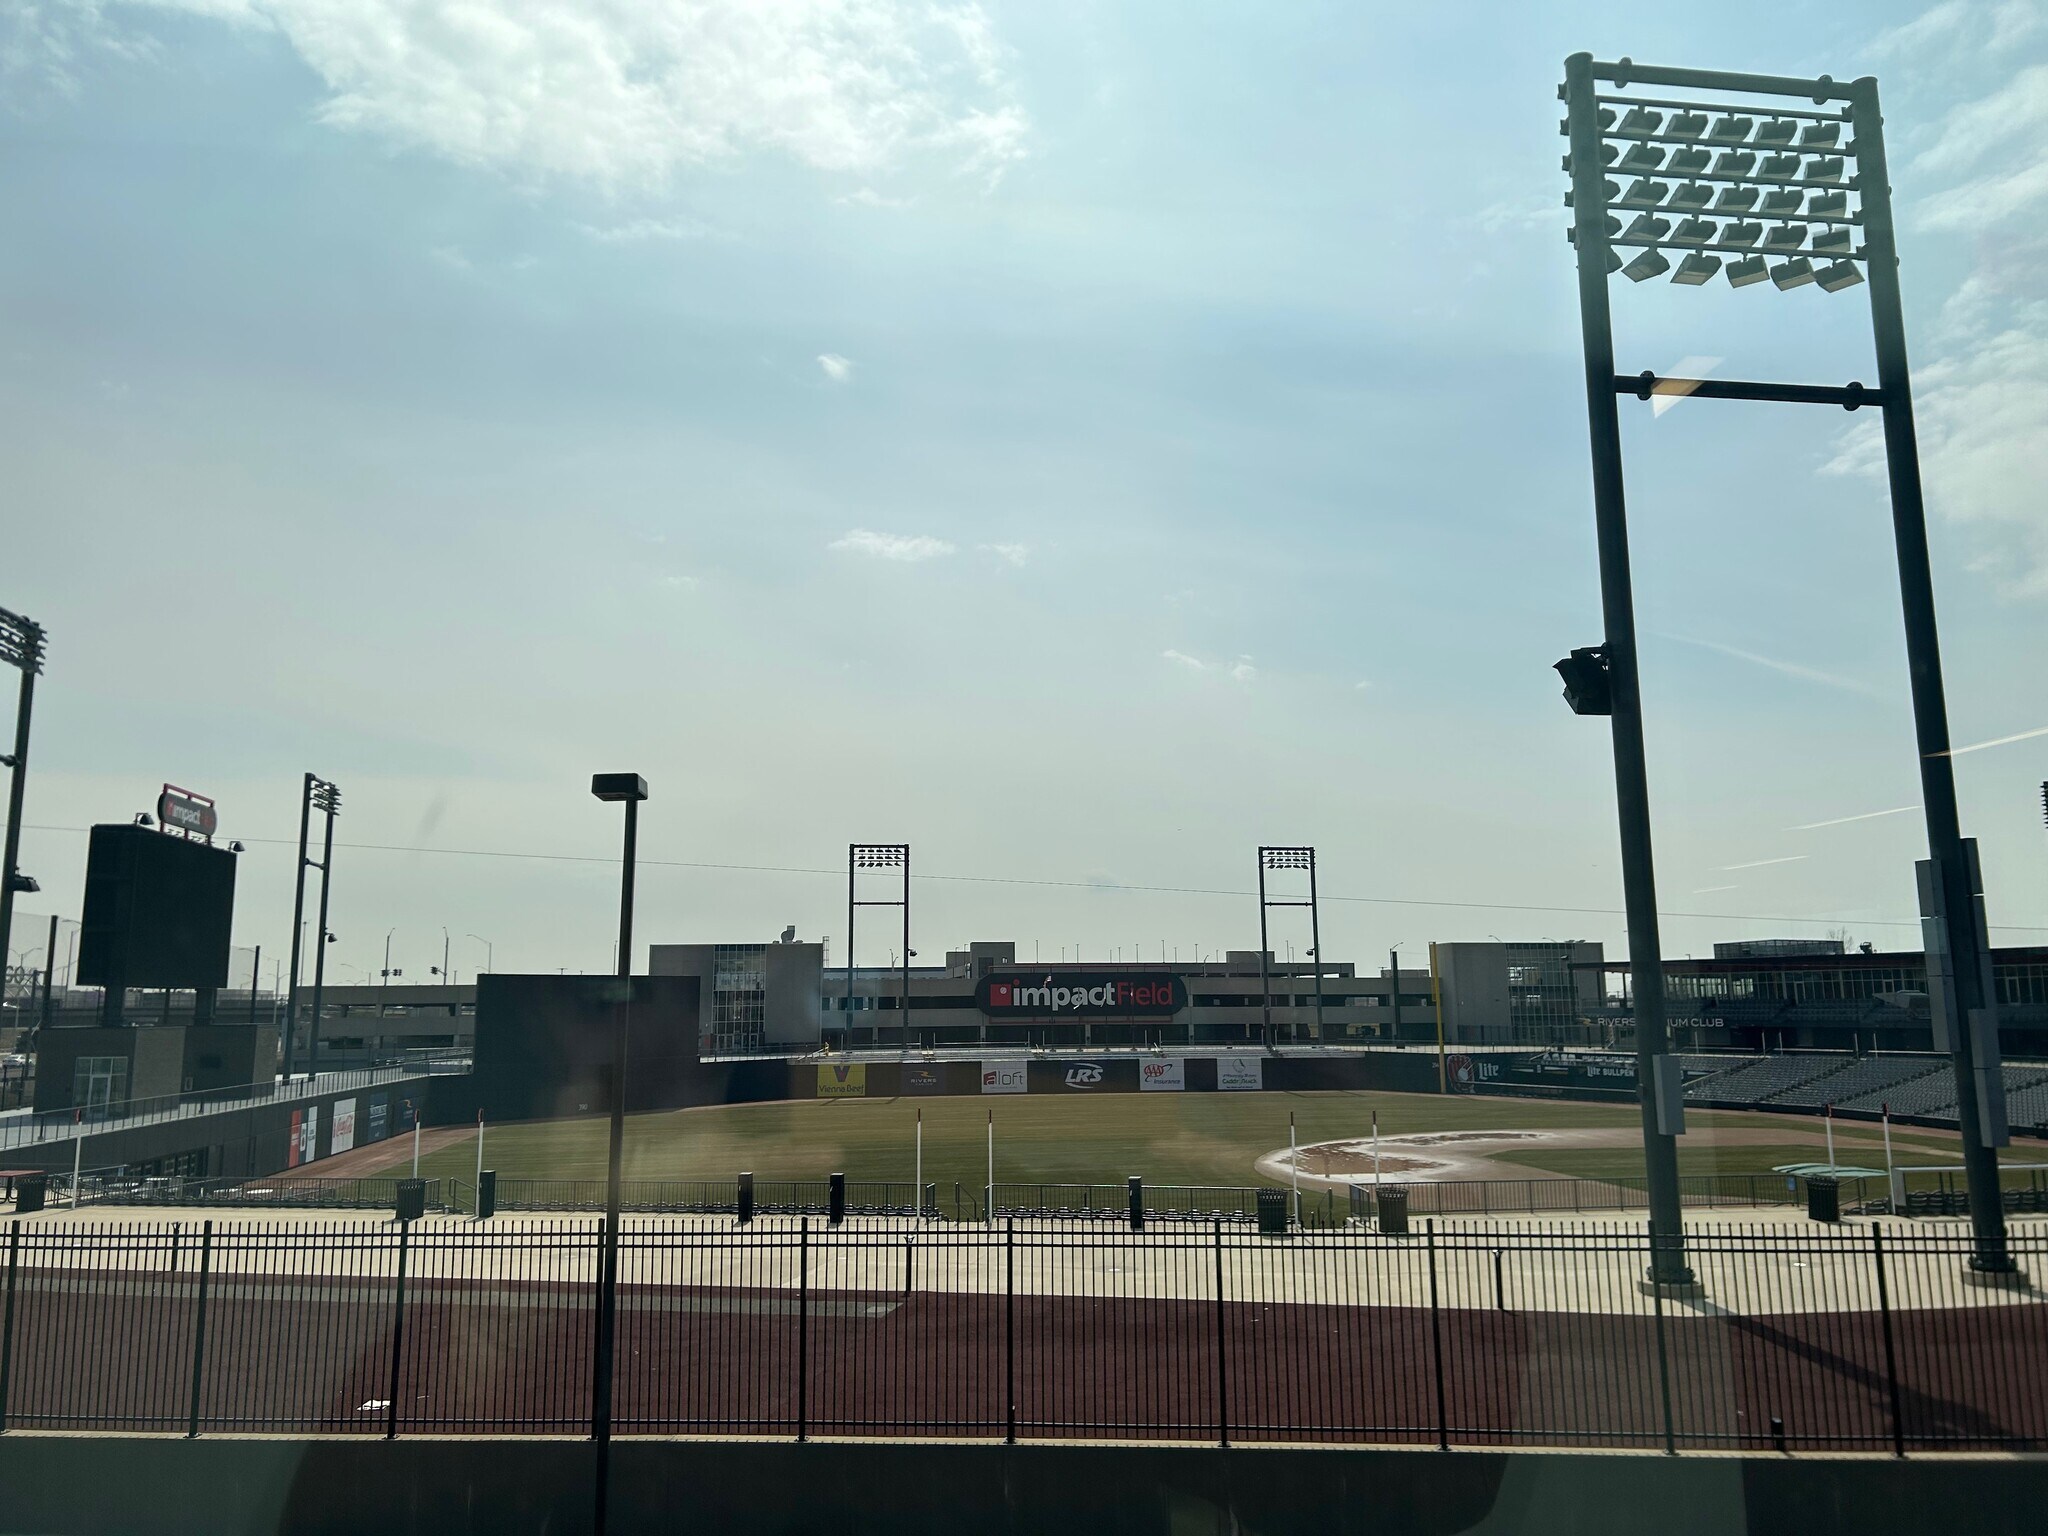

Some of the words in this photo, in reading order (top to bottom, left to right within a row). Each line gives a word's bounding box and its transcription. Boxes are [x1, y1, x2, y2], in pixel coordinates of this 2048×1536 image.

[1598, 1017, 1636, 1026] RIVERS
[1690, 1018, 1725, 1027] CLUB
[1065, 1069, 1103, 1082] LRS
[1146, 1065, 1163, 1076] AAA
[1478, 1063, 1499, 1080] Lite
[1602, 1068, 1634, 1077] BULLPEN
[984, 1071, 1023, 1085] aloft
[819, 1084, 846, 1093] Vienna
[847, 1084, 864, 1094] Beef
